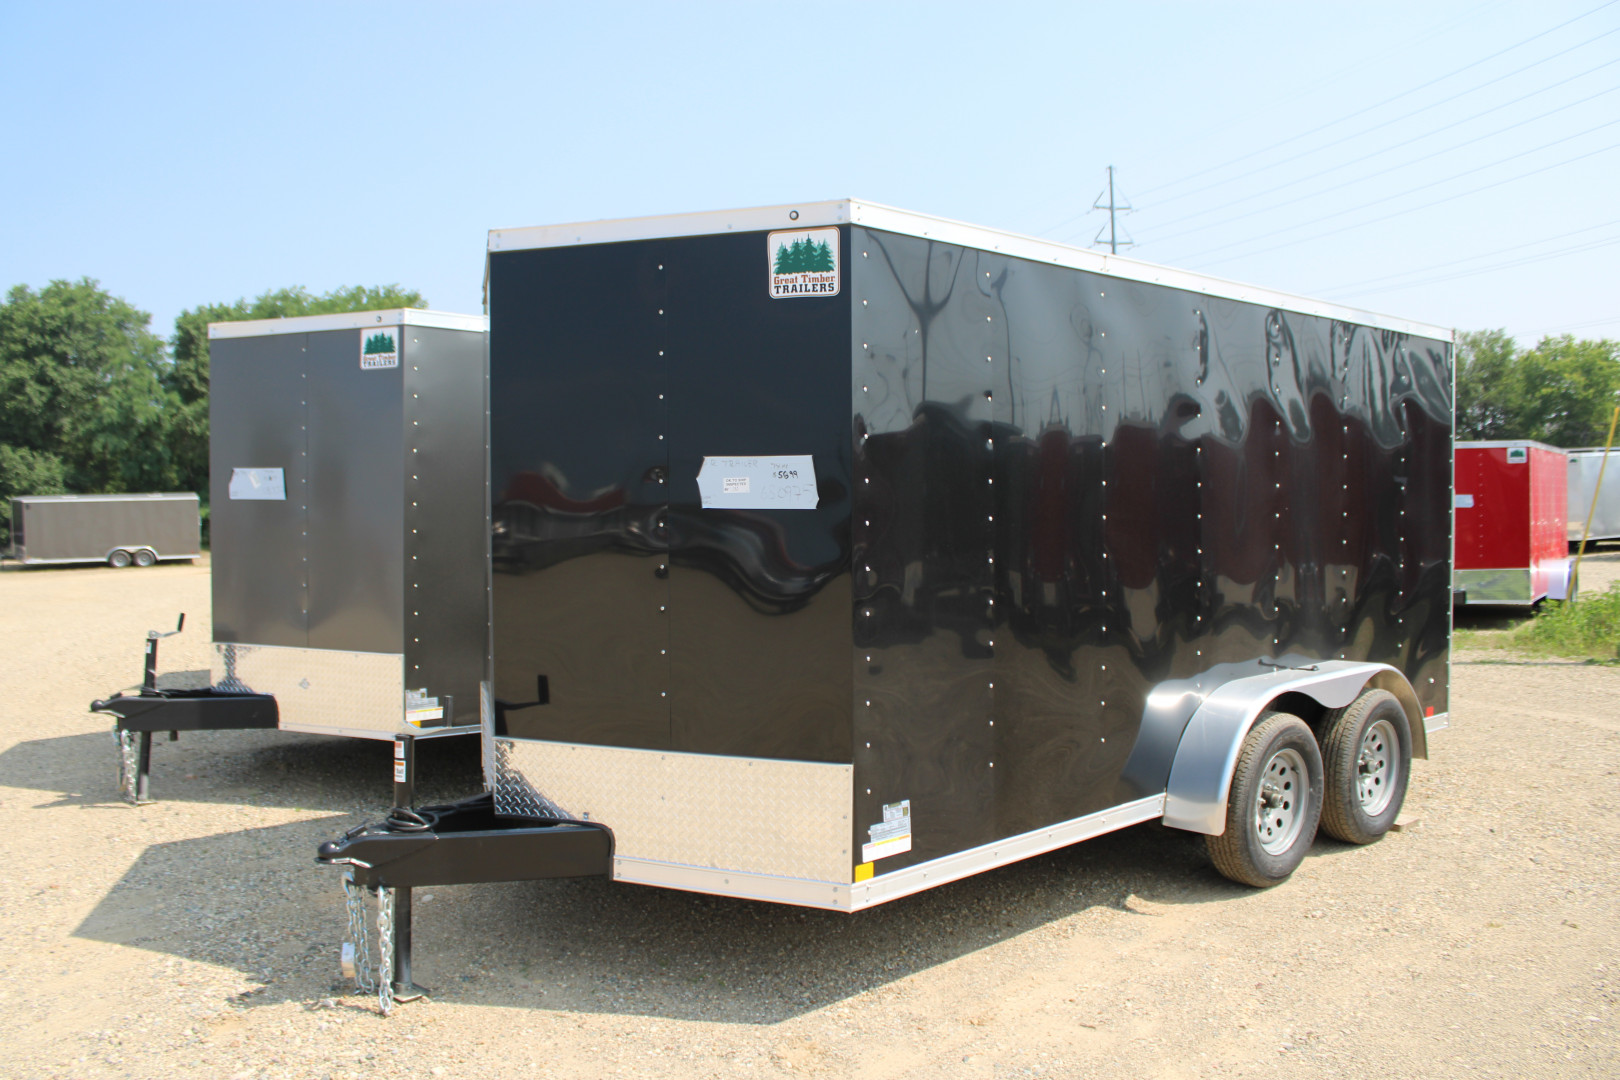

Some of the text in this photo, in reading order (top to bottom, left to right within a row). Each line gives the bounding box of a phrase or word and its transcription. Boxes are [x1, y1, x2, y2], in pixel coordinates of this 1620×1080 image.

[774, 274, 835, 285] Great Timber
[774, 283, 835, 294] TRAILERS
